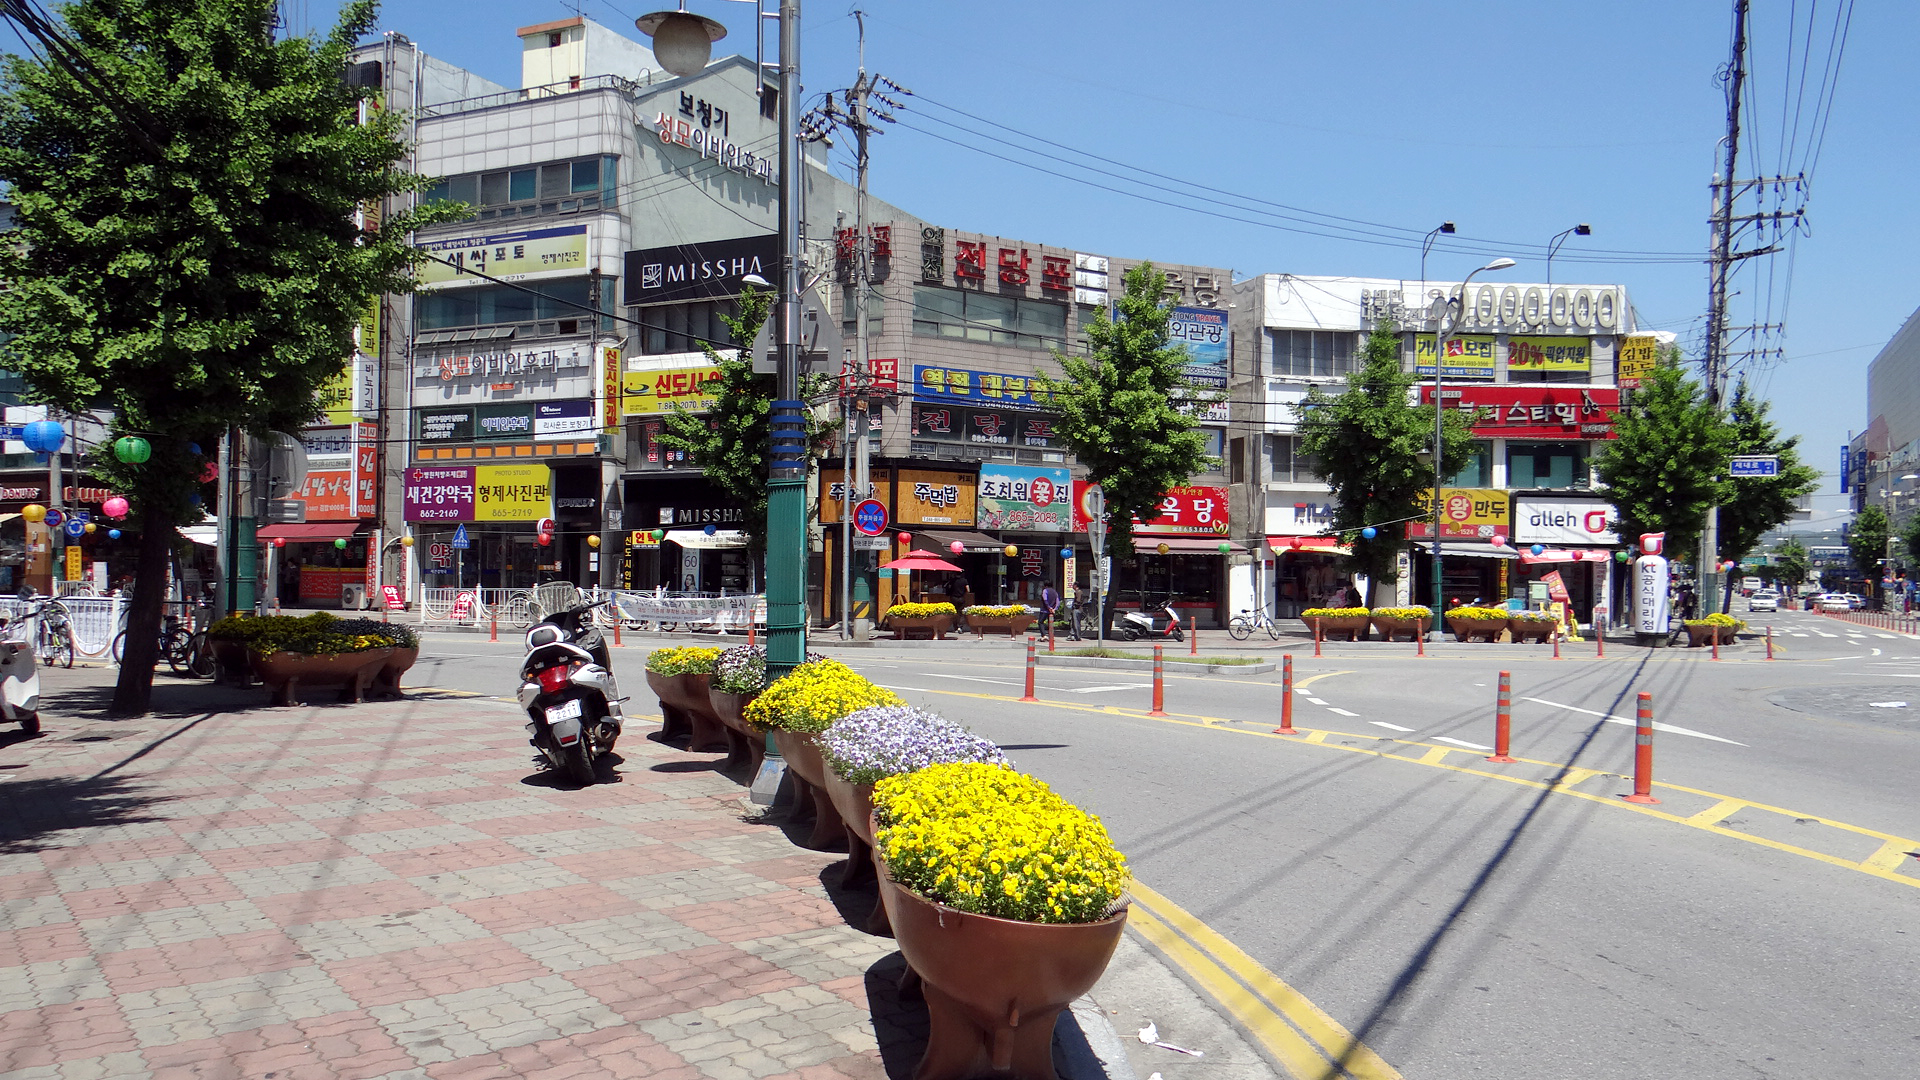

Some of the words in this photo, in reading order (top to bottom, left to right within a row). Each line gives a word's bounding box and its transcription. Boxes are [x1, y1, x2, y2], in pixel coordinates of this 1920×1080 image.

[679, 90, 728, 137] 보청기
[655, 111, 773, 186] 성모이비인후과
[447, 245, 524, 275] 새싹포토
[541, 251, 580, 264] 형제사진관
[954, 240, 1073, 292] 전당포
[667, 256, 762, 283] MISSHA
[1195, 313, 1222, 323] TRAVEL
[1165, 321, 1223, 343] 외관광
[1464, 341, 1492, 358] 모집
[1507, 341, 1544, 366] 20%
[1624, 347, 1653, 362] 김밥
[438, 350, 559, 381] 성모이비인후과
[606, 350, 617, 383] 신도시
[655, 372, 704, 398] 신도시
[921, 368, 970, 396] 역전
[481, 416, 529, 431] 이비인후과
[920, 409, 1056, 439] 전당포
[360, 451, 376, 500] 김밥
[958, 474, 973, 483] 커피
[406, 485, 474, 504] 새건강약국
[478, 485, 548, 503] 형제사진관
[914, 482, 958, 508] 주먹밥
[982, 480, 1028, 502] 조치원
[420, 509, 459, 518] 862-2169
[492, 508, 533, 517] 865-2719
[679, 509, 743, 522] MISSHA
[1010, 510, 1058, 523] 865-2083
[1294, 502, 1334, 518] FILA
[1450, 498, 1469, 519] 왕
[1475, 501, 1505, 518] 만두
[1530, 511, 1577, 527] olleh
[430, 543, 454, 567] 약
[684, 555, 698, 568] 60
[1021, 549, 1043, 576] 꽃
[1641, 561, 1656, 574] kt
[1641, 575, 1656, 631] 공식대리점
